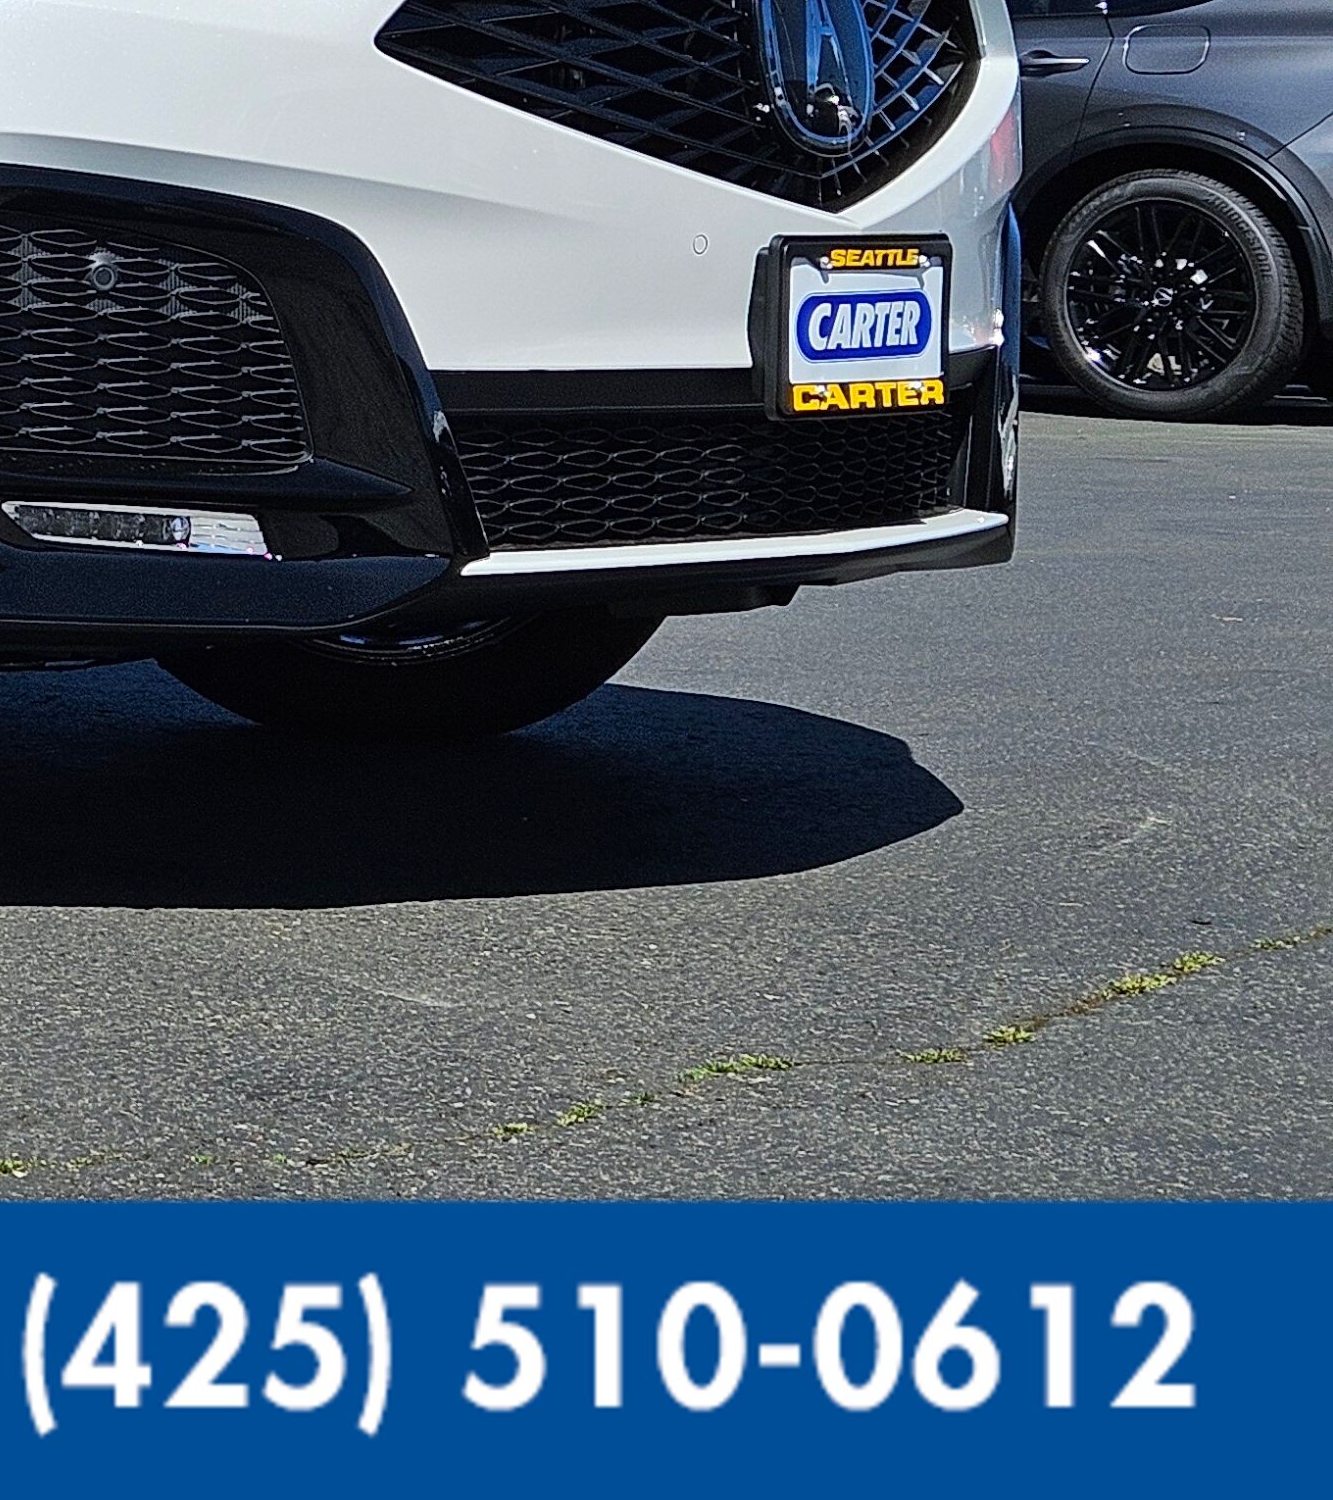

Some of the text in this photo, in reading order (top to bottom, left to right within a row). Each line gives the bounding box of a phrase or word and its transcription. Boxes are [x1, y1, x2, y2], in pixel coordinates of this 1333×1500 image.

[830, 248, 920, 268] SEATTLE
[808, 300, 921, 352] CARTER
[793, 380, 945, 412] CARTER
